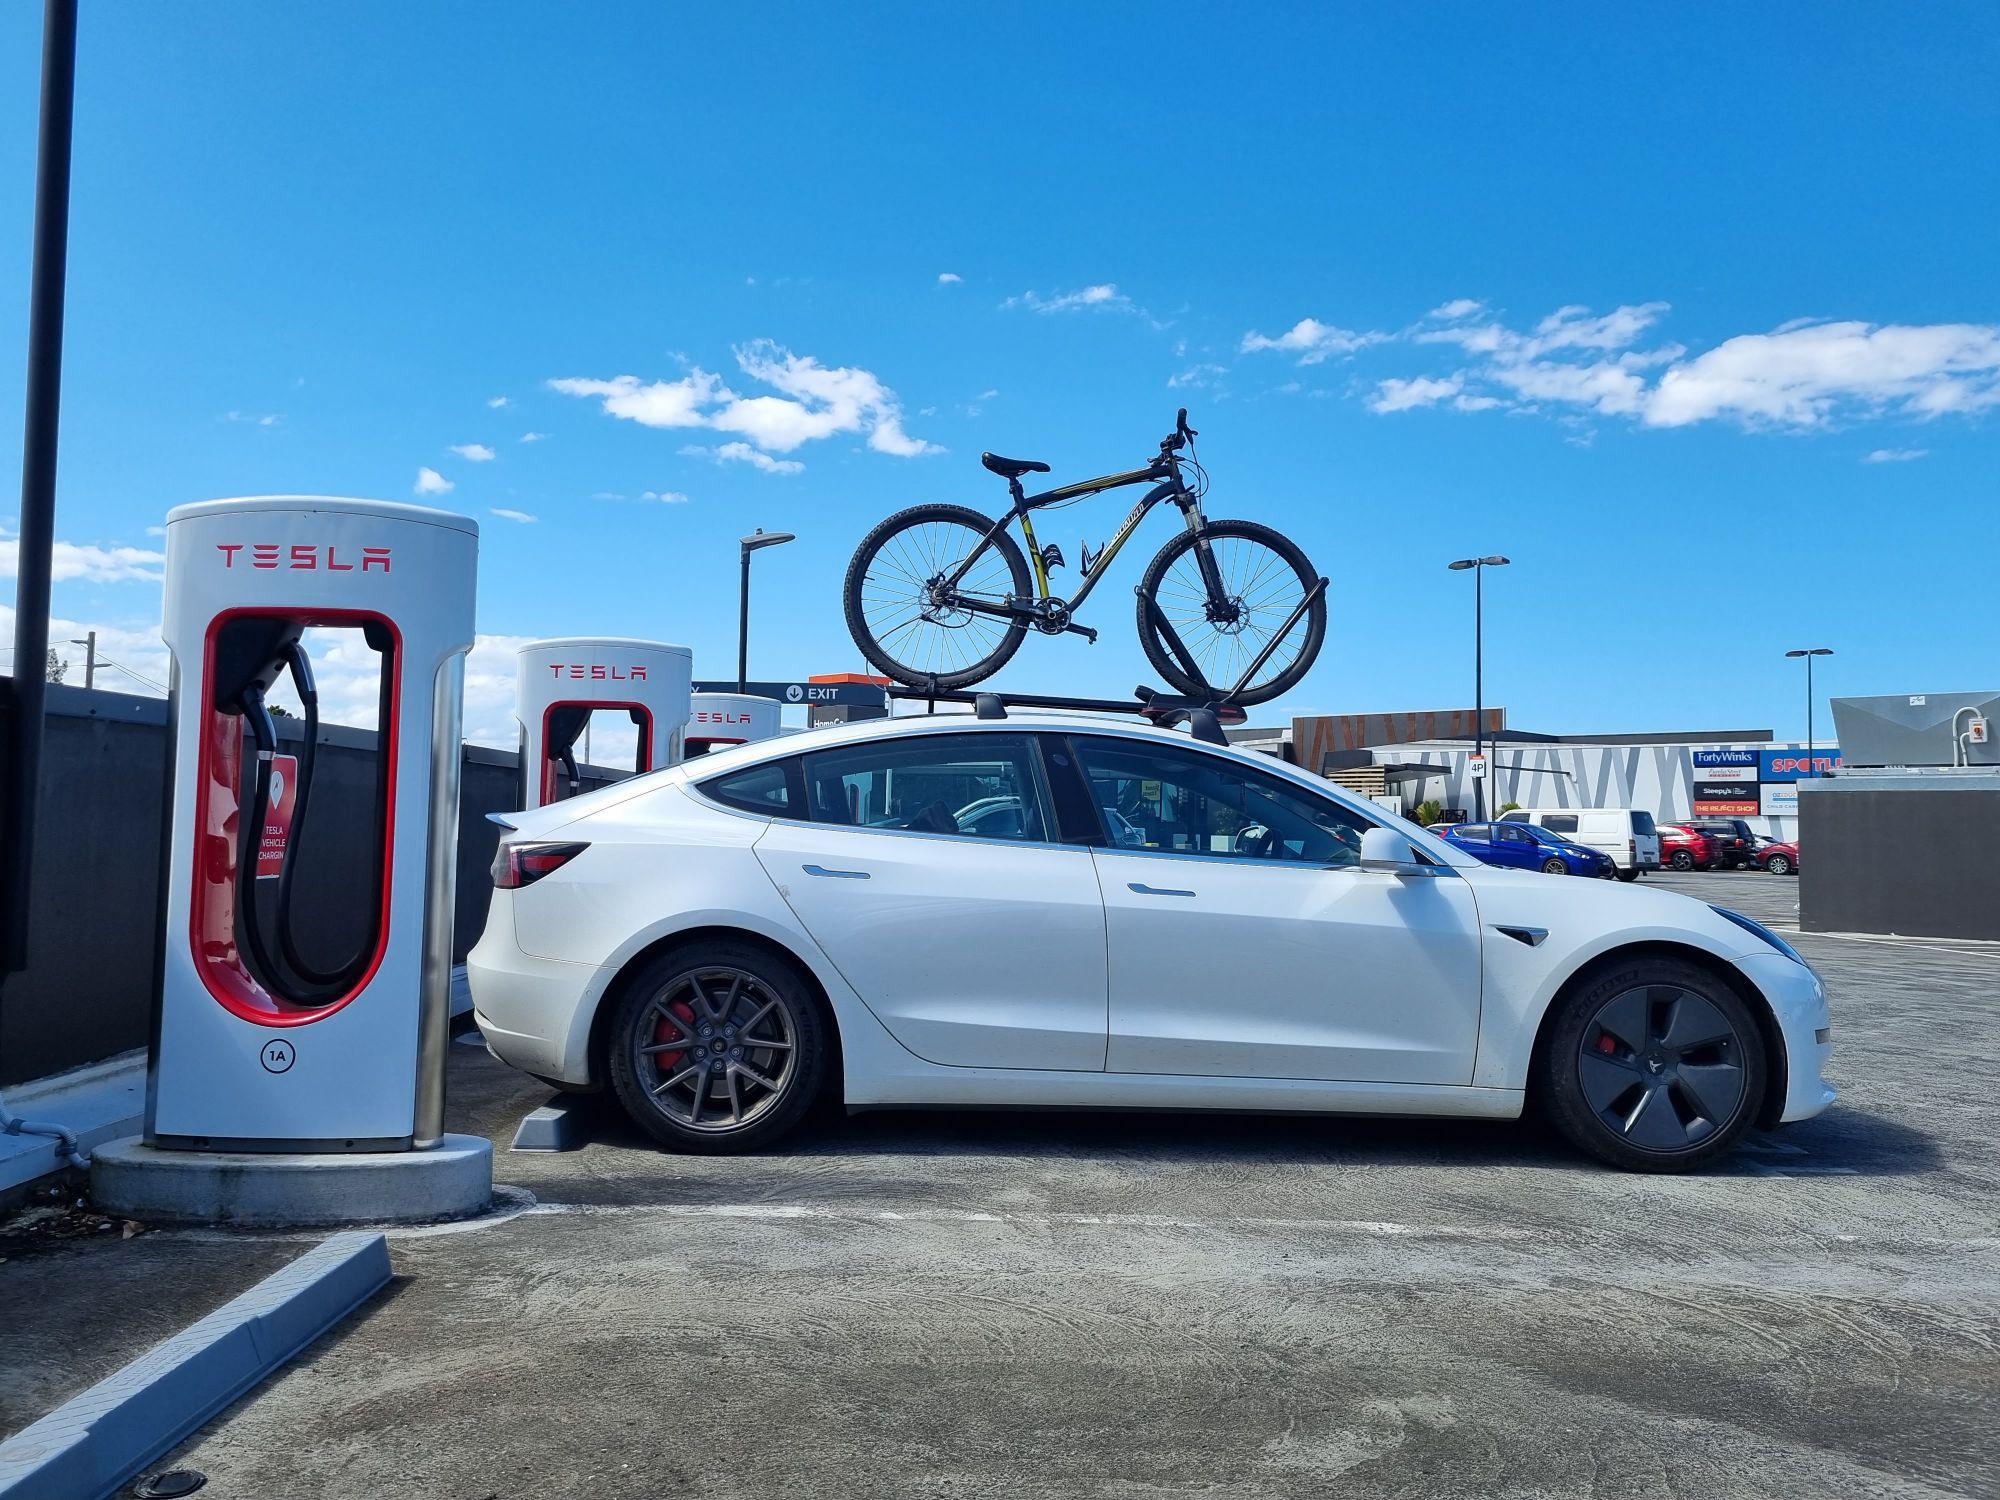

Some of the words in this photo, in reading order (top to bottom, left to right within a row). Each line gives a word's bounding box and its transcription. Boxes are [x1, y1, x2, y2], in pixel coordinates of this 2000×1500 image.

[216, 544, 392, 573] TESLA
[548, 664, 648, 681] TESLA
[807, 688, 839, 700] EXIT
[691, 712, 751, 724] ESLA
[1698, 752, 1721, 763] Forty
[1722, 751, 1752, 761] Winks
[1471, 763, 1484, 772] 4P
[1771, 757, 1843, 772] SPOTLI
[1710, 804, 1736, 812] REJECT
[266, 826, 284, 835] TESLA
[262, 839, 286, 847] VEHICLE
[258, 851, 284, 860] CHARGIN
[269, 1050, 287, 1062] 1A
